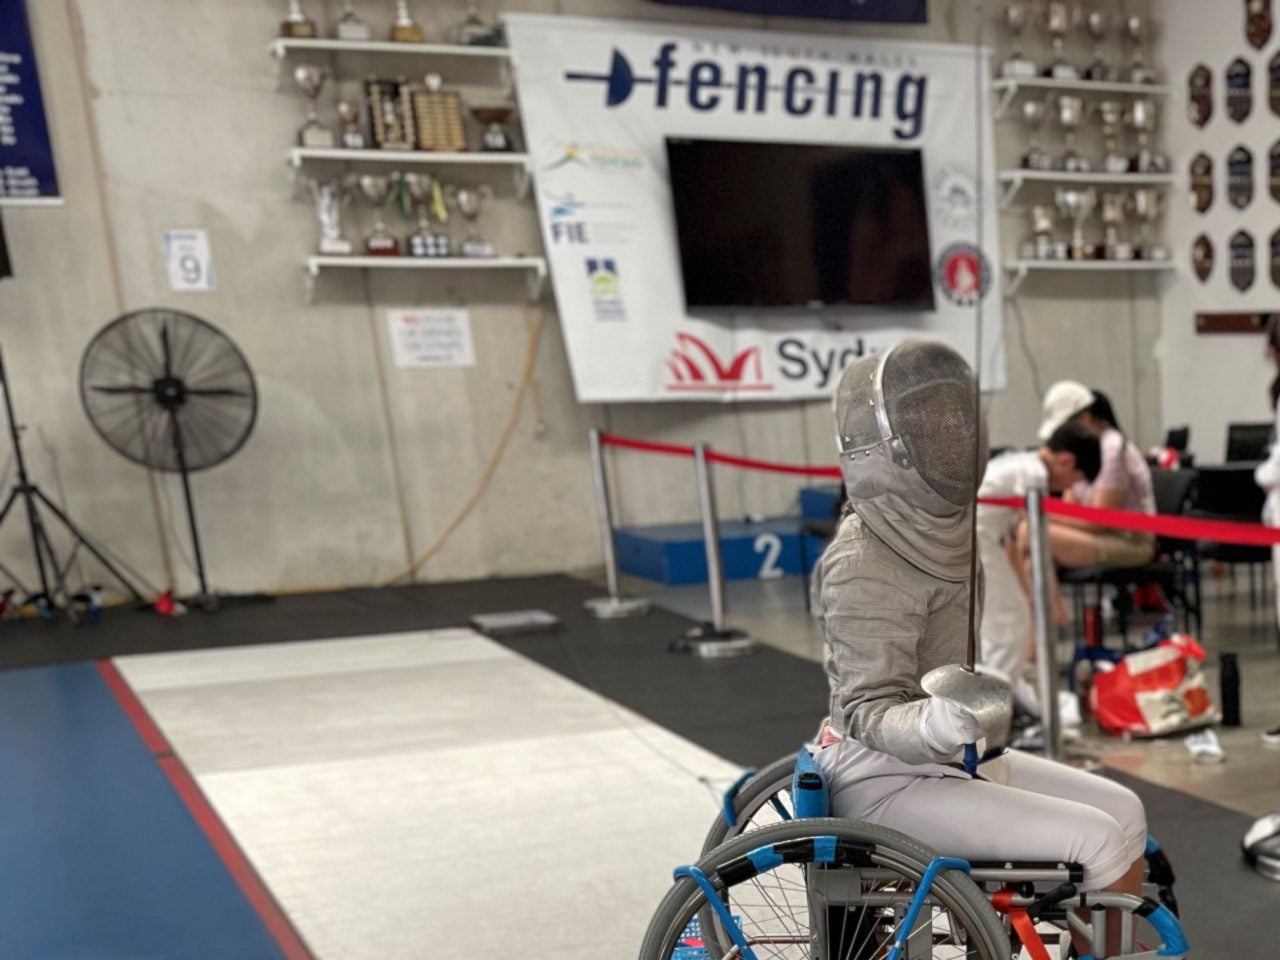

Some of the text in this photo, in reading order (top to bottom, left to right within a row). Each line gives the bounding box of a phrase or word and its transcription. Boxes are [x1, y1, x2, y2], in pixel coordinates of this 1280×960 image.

[654, 43, 930, 141] fencing
[551, 221, 589, 244] FIE
[179, 254, 202, 285] 9
[753, 533, 784, 580] 2
